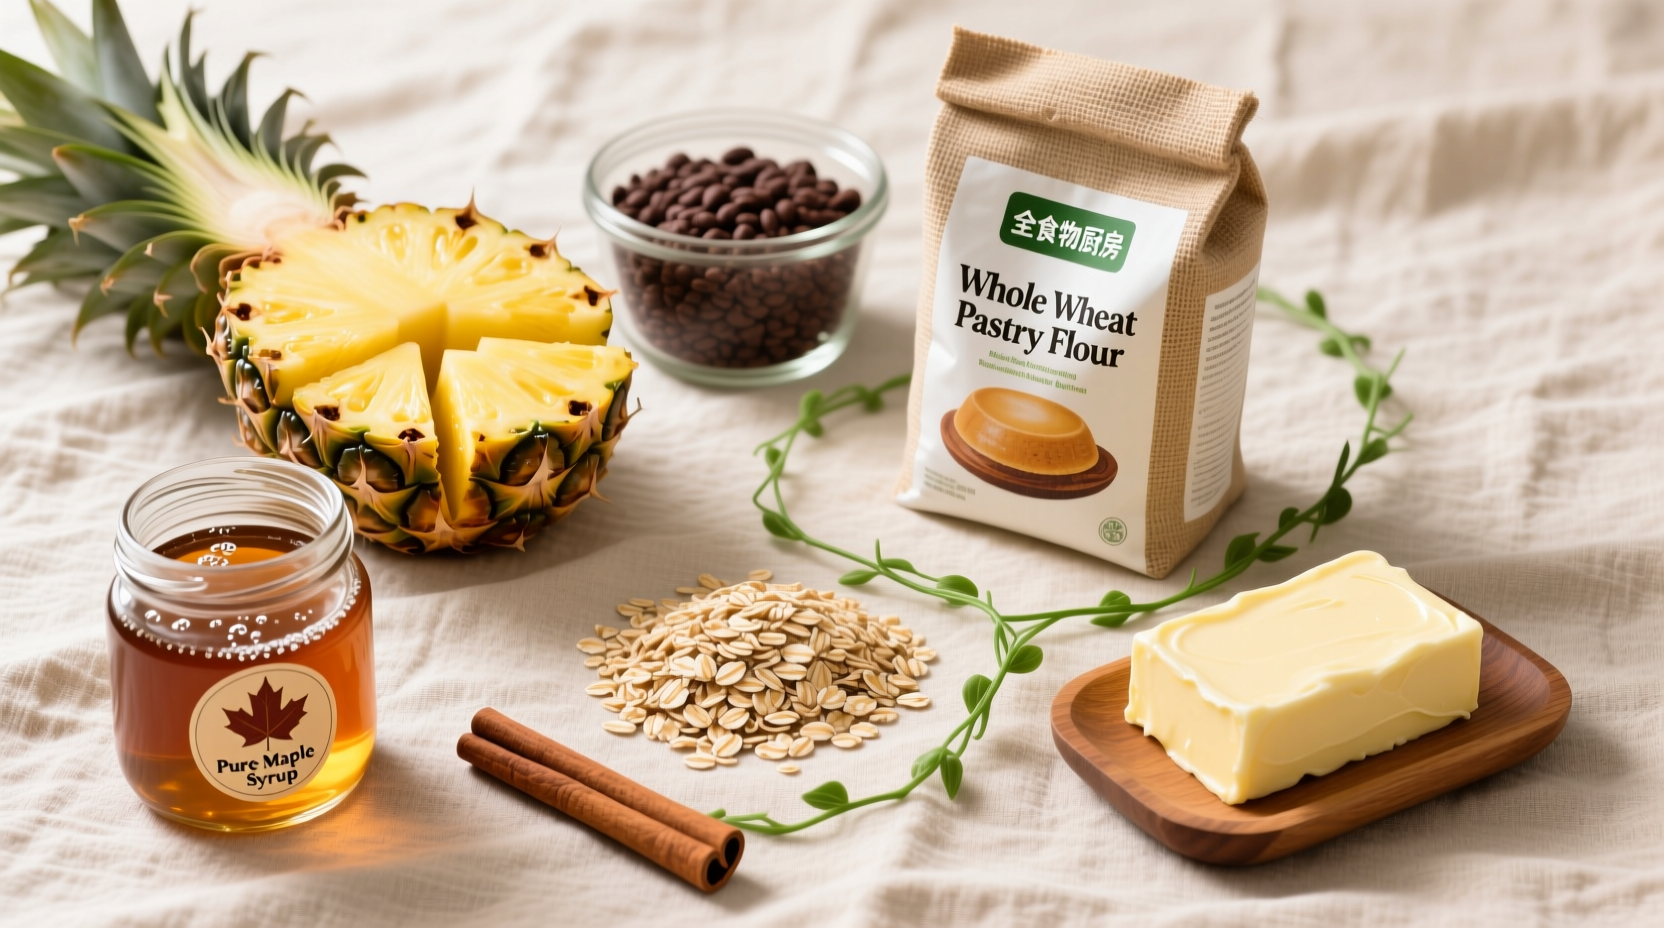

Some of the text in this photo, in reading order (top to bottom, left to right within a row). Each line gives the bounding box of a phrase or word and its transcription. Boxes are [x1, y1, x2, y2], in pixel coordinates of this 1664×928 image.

[1011, 210, 1124, 260] 全食物厨房
[960, 263, 1137, 336] Whole Wheat
[955, 299, 1044, 355] Pastry
[1048, 326, 1125, 367] Flour
[217, 745, 315, 773] Pure Maple
[247, 770, 298, 790] Syrup
